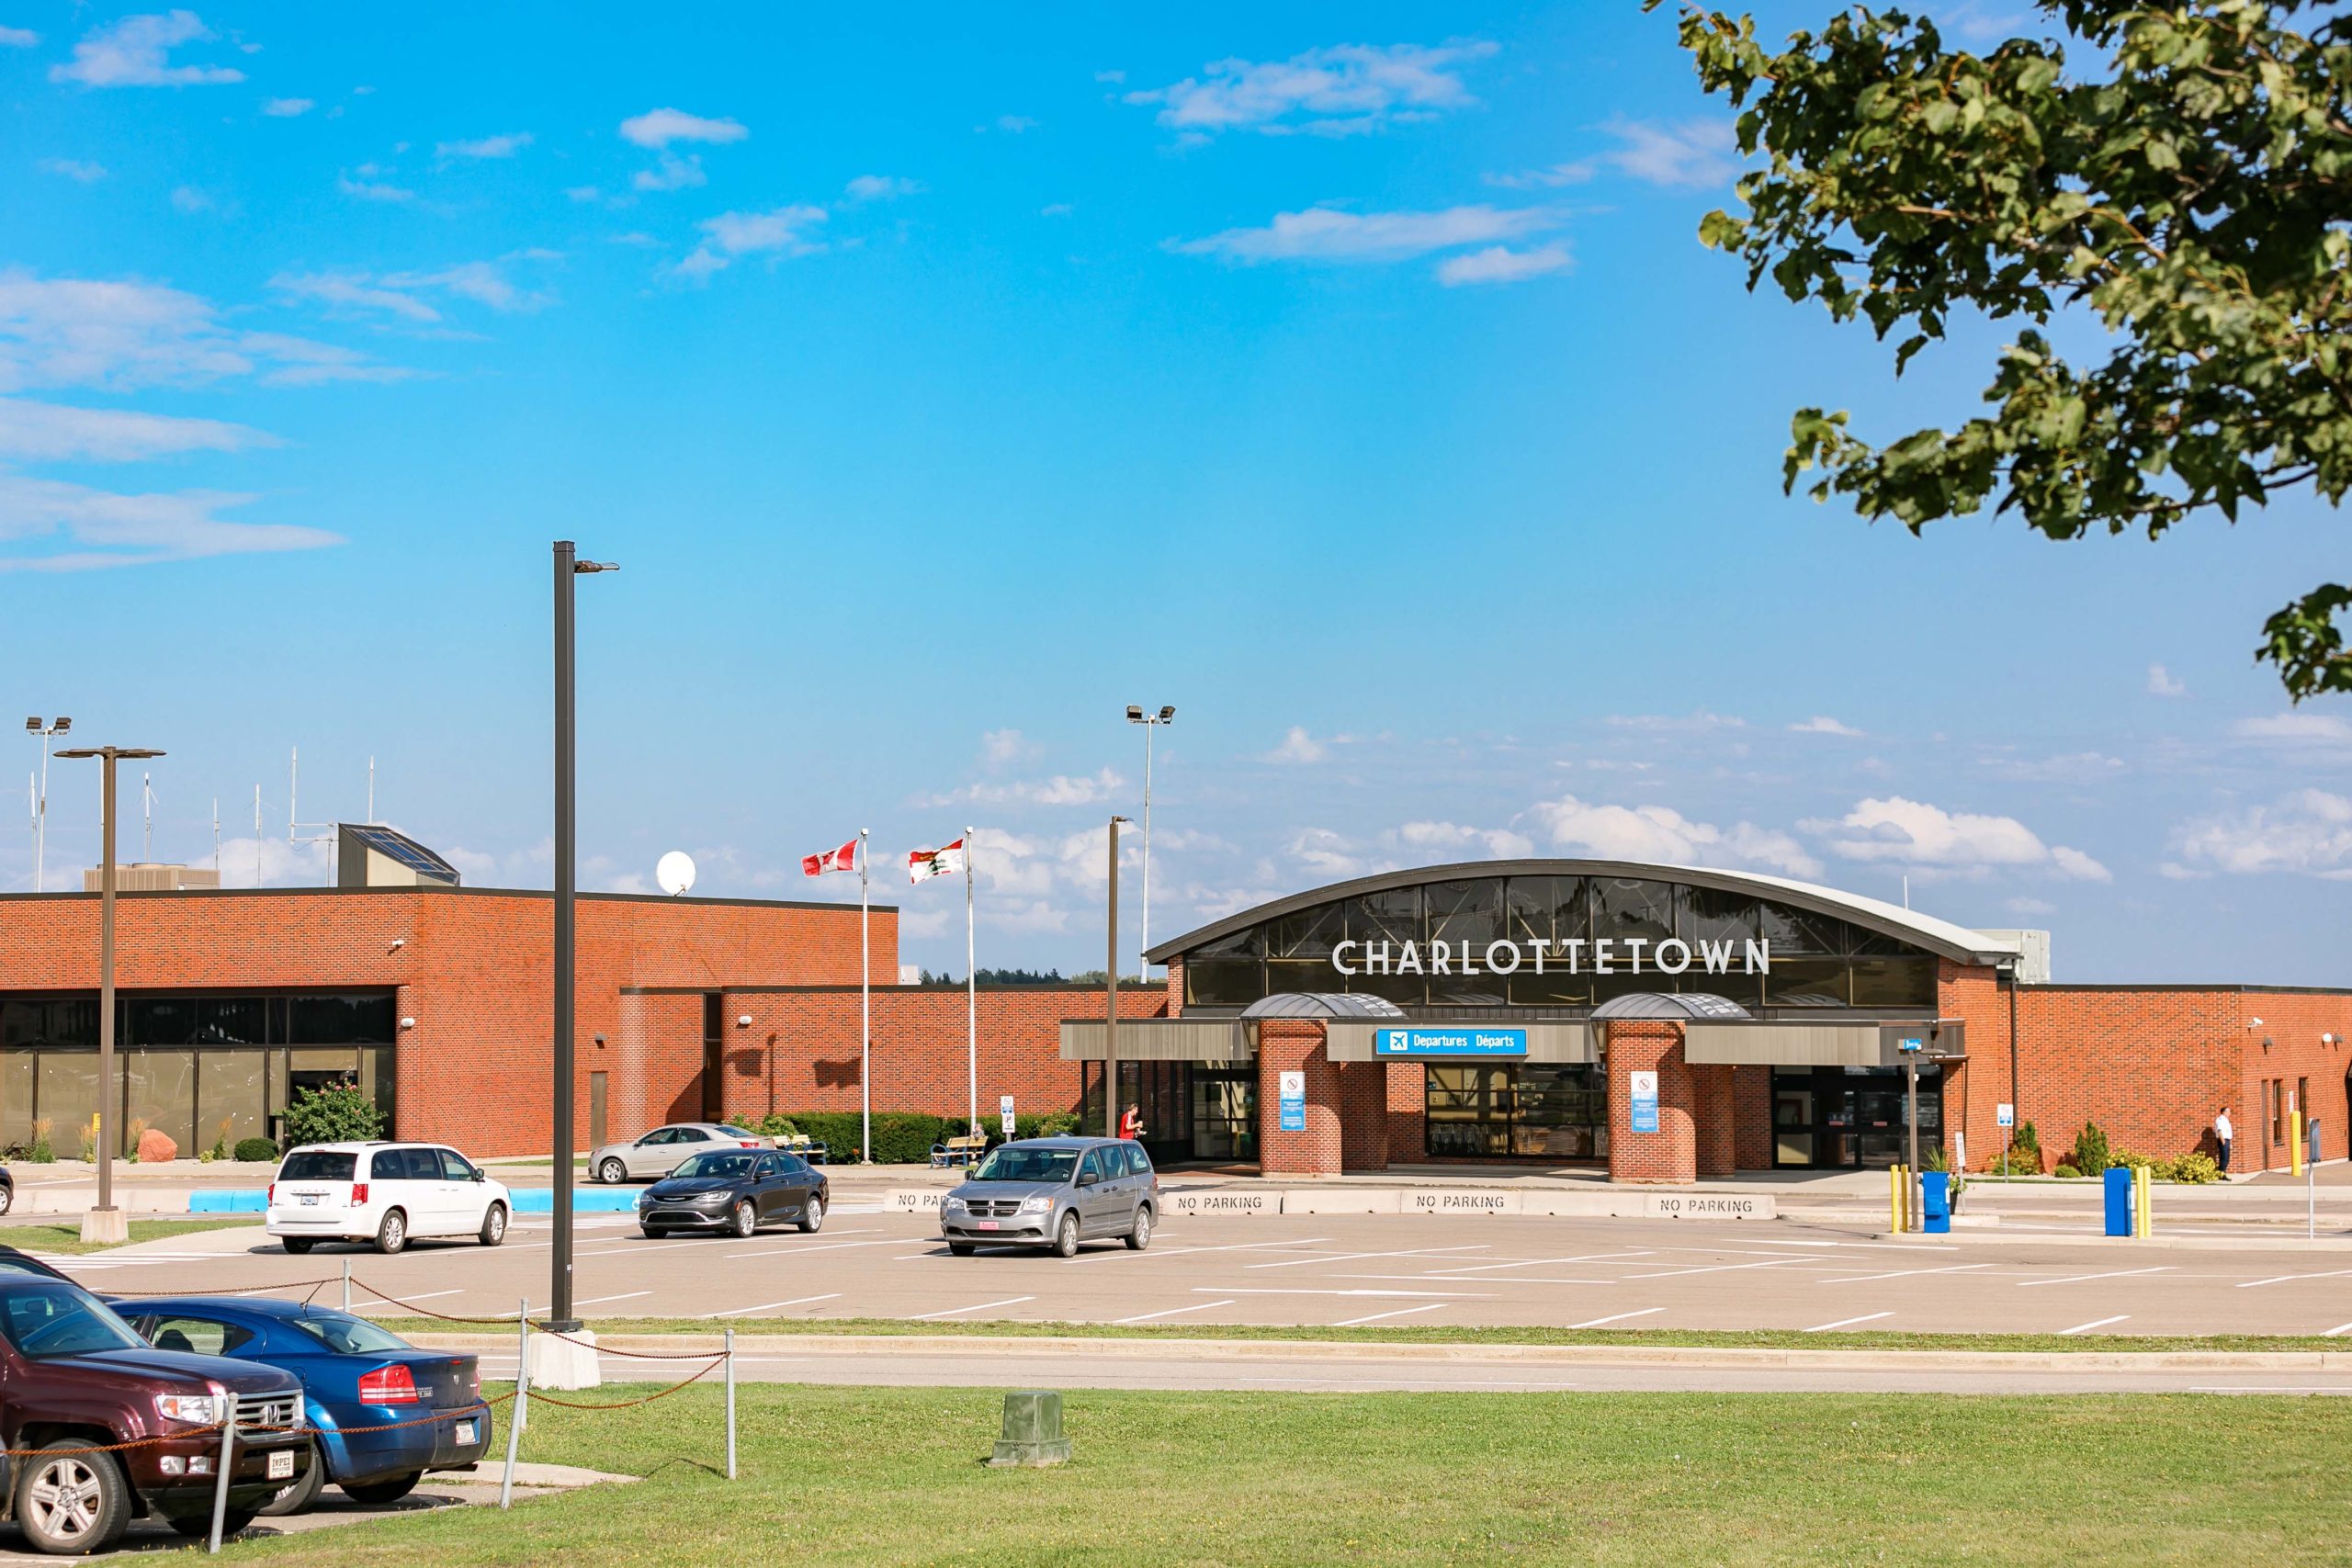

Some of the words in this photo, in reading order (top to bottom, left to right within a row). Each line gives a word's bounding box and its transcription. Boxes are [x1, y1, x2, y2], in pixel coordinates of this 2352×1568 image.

[1331, 938, 1770, 976] CHARLOTTETOWN
[1413, 1034, 1467, 1048] Departures
[1476, 1034, 1514, 1049] Départs
[899, 1195, 916, 1206] NO
[1178, 1197, 1196, 1209] NO
[1204, 1196, 1261, 1209] PARKING
[1417, 1195, 1436, 1207] NO
[1443, 1196, 1504, 1208] PARKING
[1660, 1199, 1680, 1212] NO
[1689, 1200, 1752, 1213] PARKING
